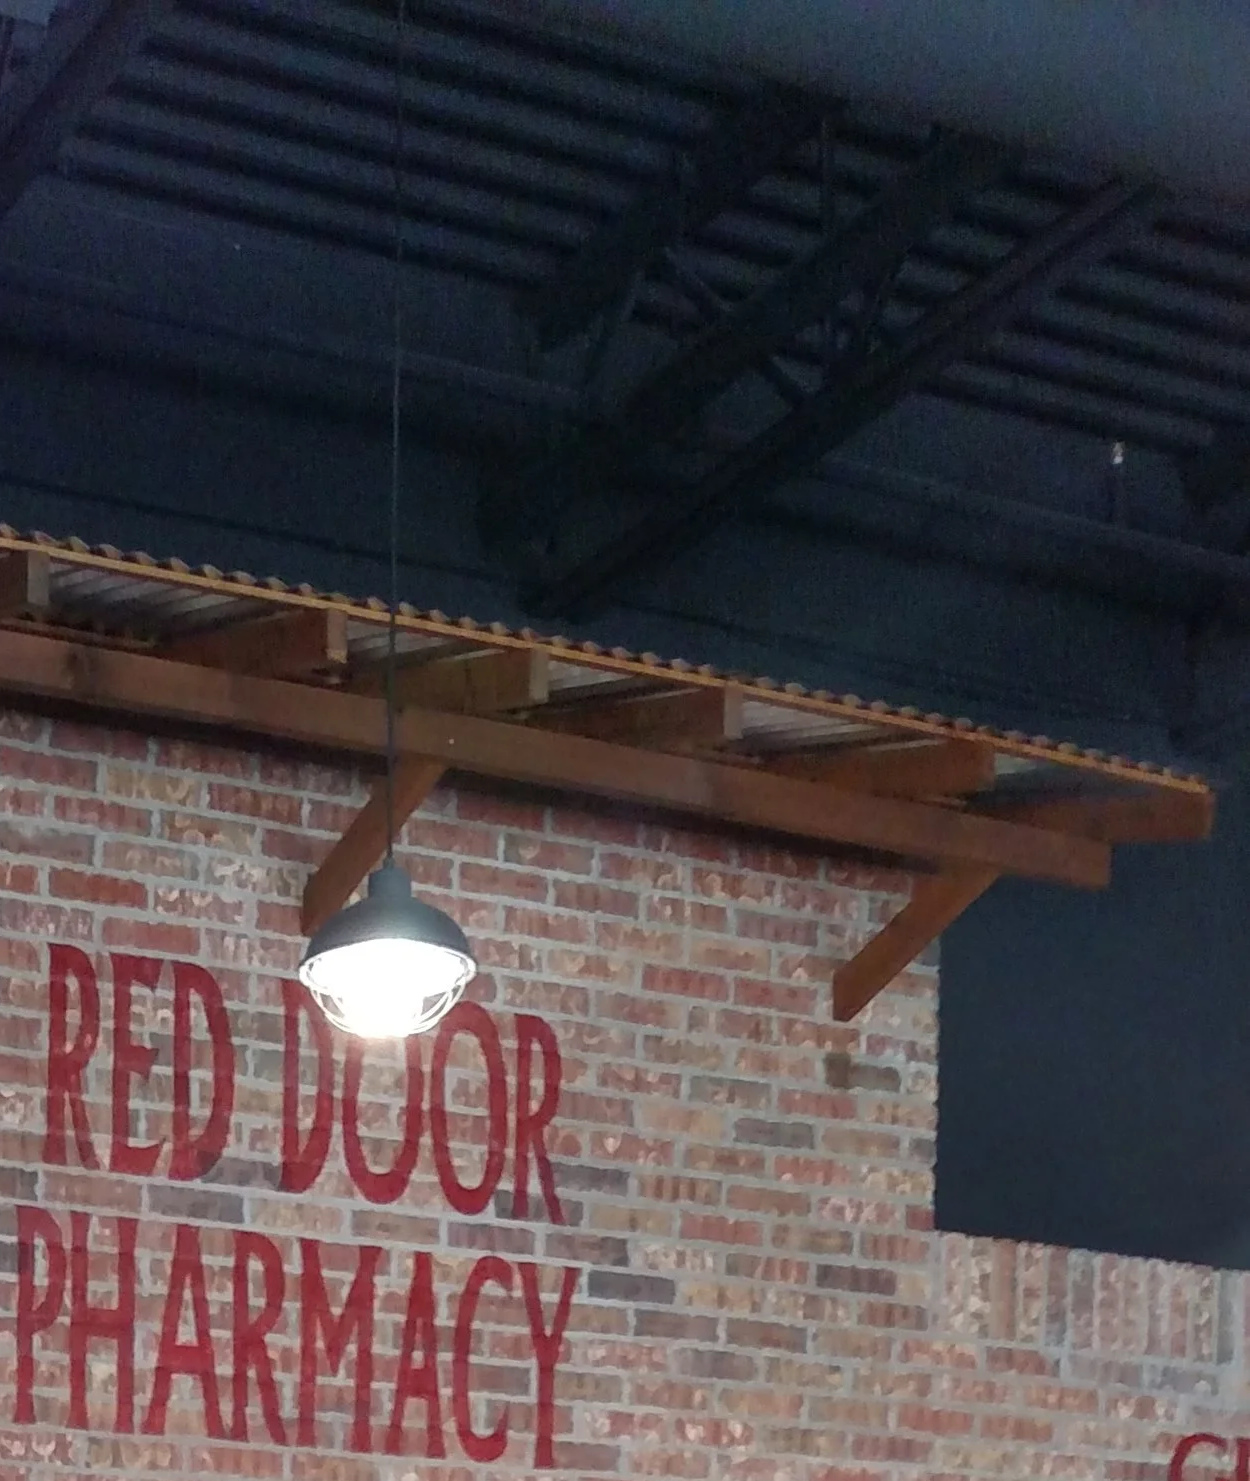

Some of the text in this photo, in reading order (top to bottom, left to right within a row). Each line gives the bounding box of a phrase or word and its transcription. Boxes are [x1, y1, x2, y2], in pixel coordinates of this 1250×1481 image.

[41, 942, 568, 1225] RED DOOR
[11, 1204, 580, 1470] PHARMACY
